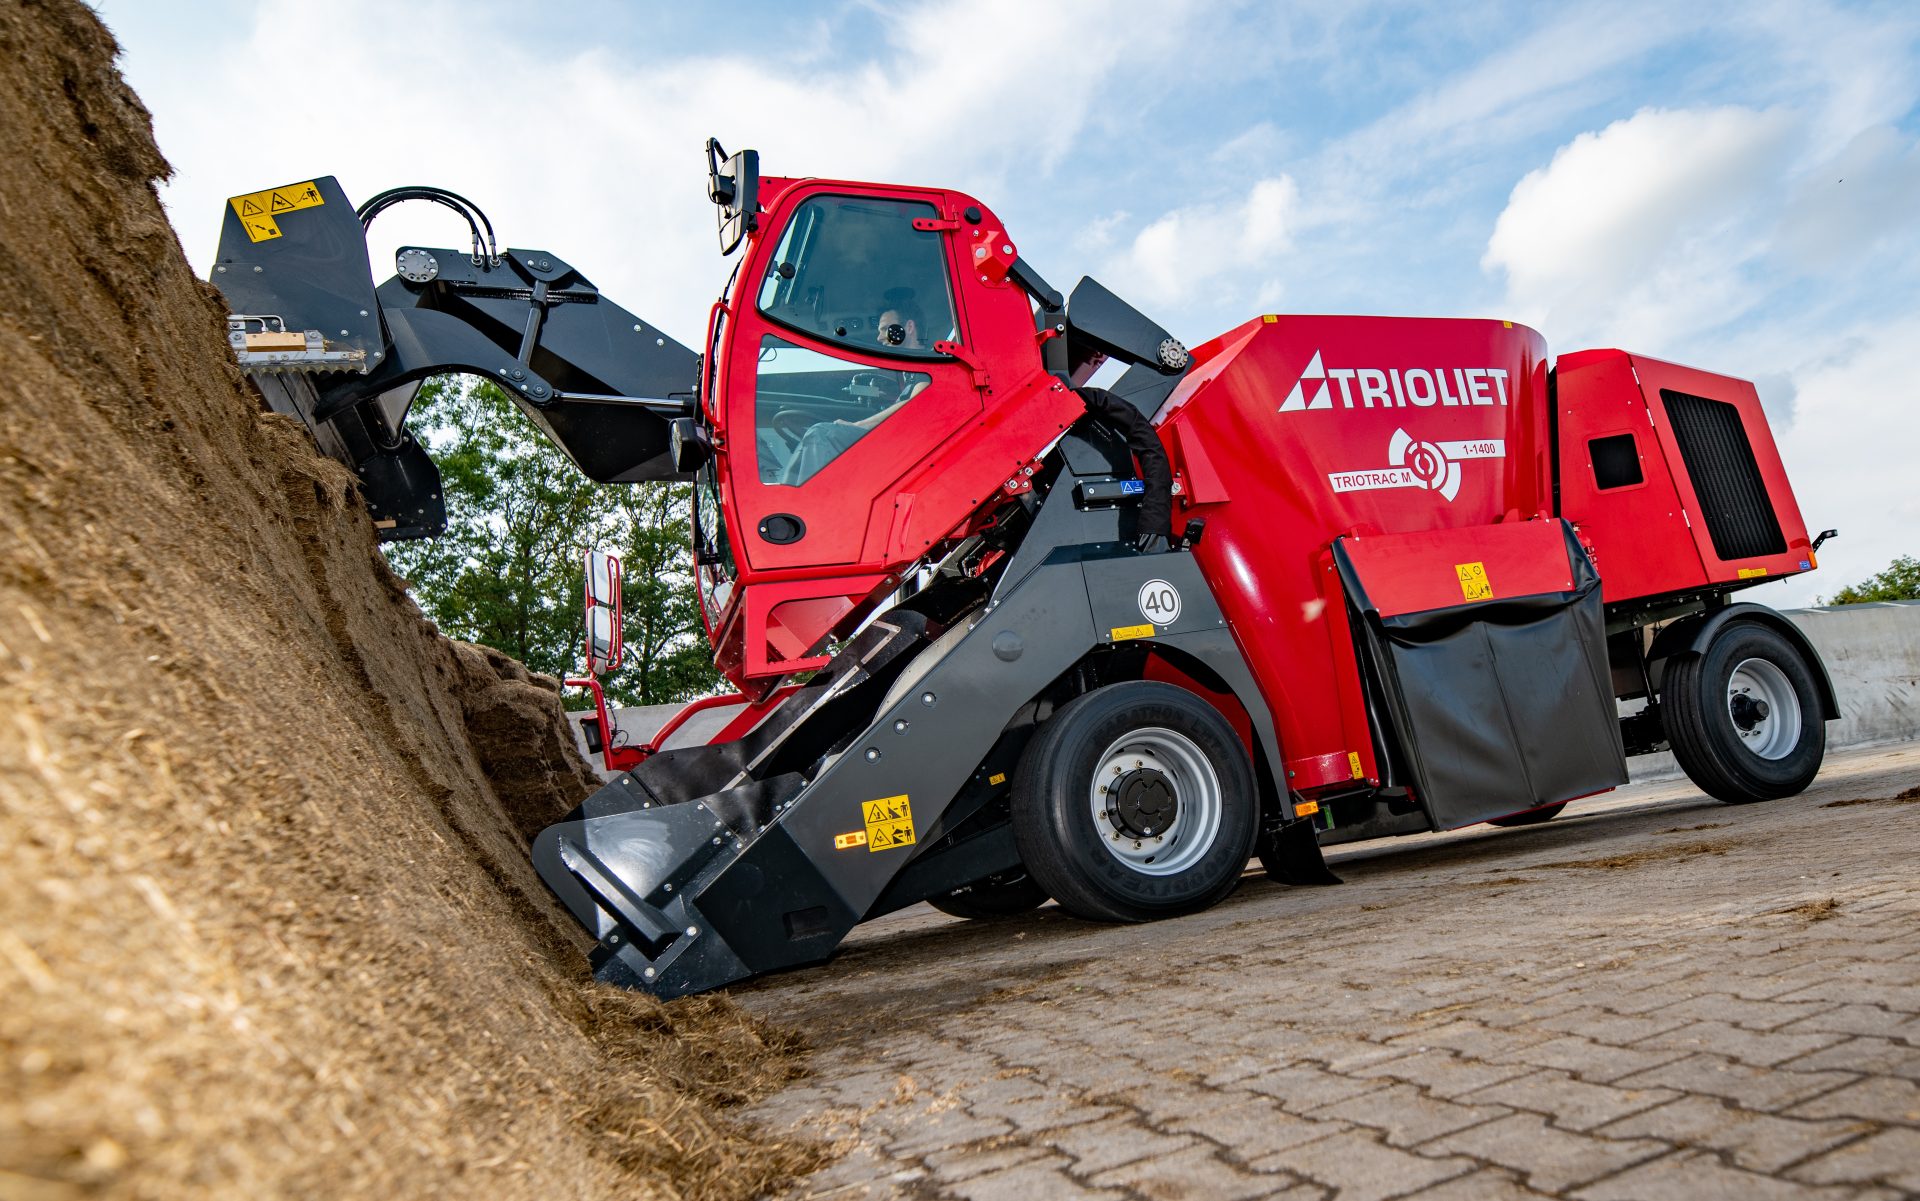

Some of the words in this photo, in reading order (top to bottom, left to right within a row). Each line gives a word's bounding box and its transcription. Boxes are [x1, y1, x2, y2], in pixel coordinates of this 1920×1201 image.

[1328, 368, 1508, 408] TRIOLIET
[1463, 443, 1496, 455] 1-1400
[1334, 472, 1398, 488] TRIOTRAC
[1401, 471, 1412, 483] M
[1145, 589, 1176, 614] 40
